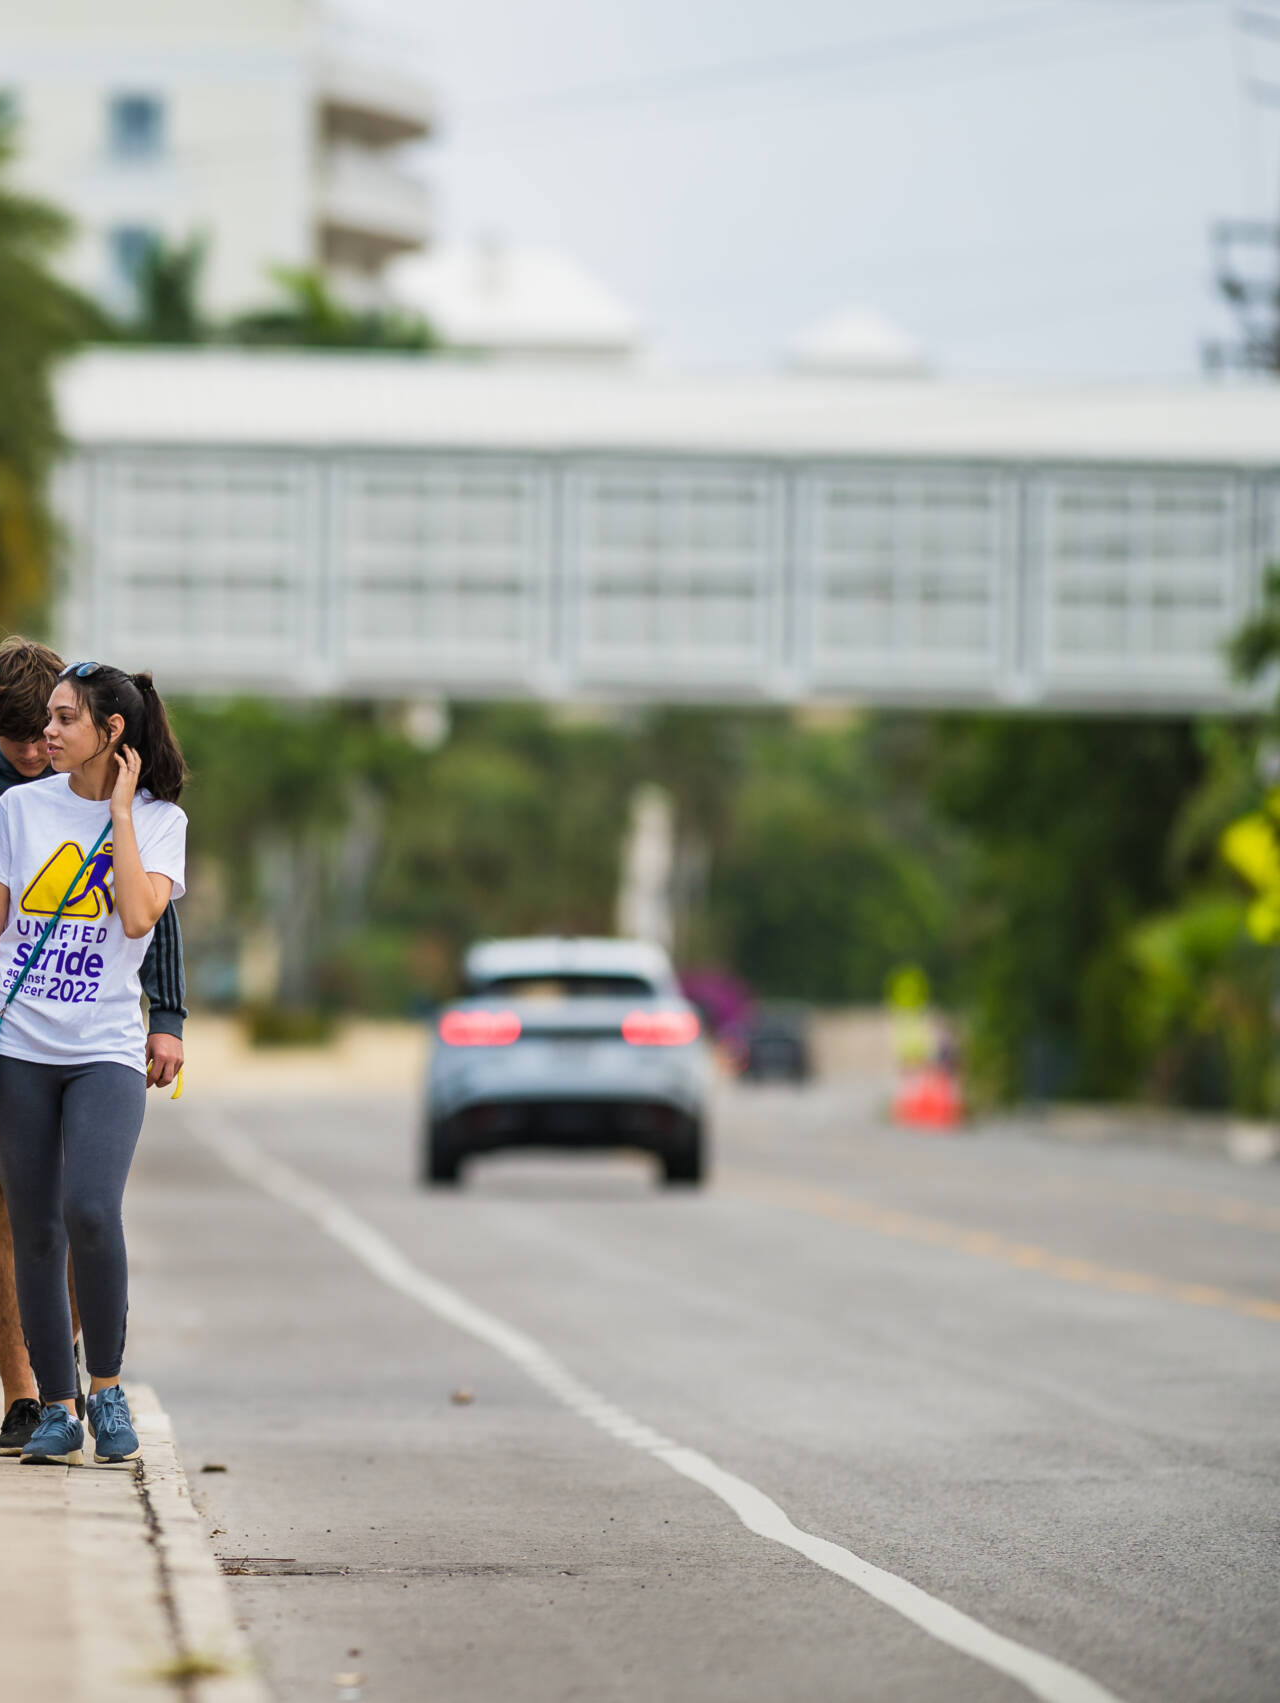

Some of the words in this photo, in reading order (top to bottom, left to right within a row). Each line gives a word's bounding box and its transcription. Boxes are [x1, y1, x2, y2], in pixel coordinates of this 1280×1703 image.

[16, 919, 108, 944] UNIFIED
[6, 968, 46, 985] aginst
[46, 977, 100, 1003] 2022
